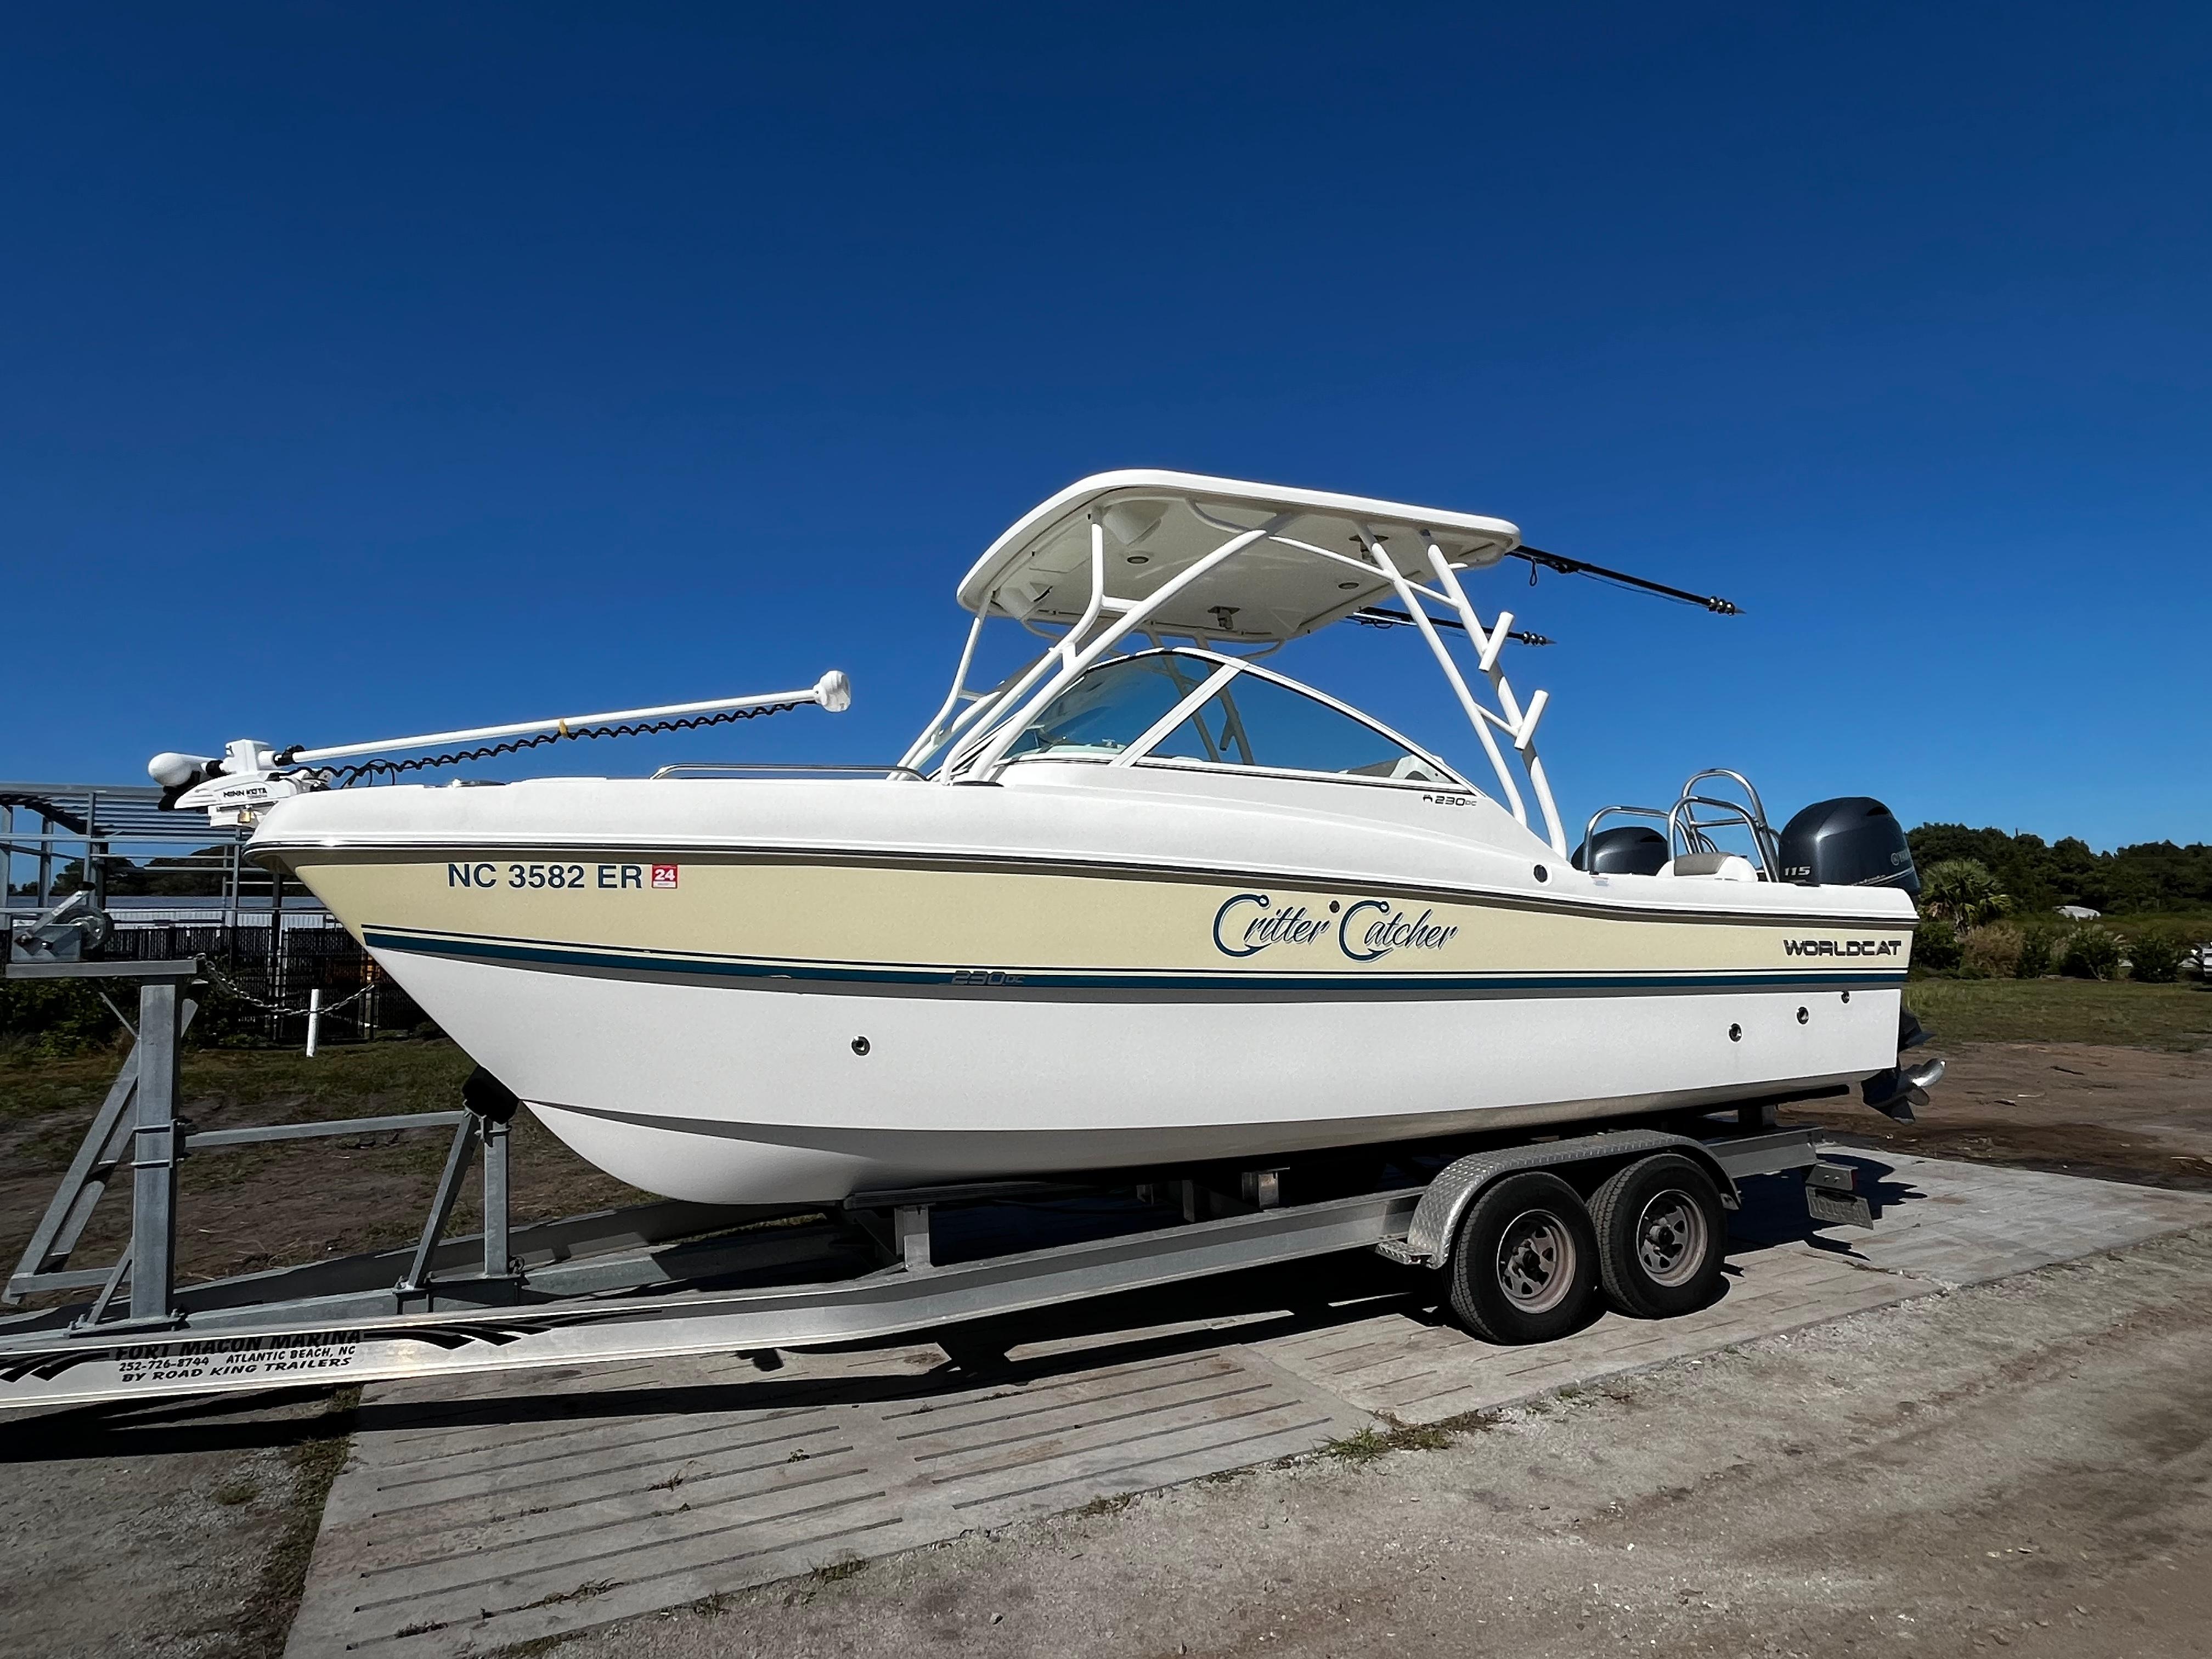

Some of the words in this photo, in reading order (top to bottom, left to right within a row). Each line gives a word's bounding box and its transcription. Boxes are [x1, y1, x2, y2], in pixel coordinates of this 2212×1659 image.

[448, 863, 496, 888] NC
[508, 864, 585, 889] 3582
[597, 865, 642, 889] ER
[654, 868, 675, 881] 24
[1784, 866, 1811, 876] 115
[1212, 893, 1331, 957] Critter
[1339, 900, 1458, 962] Catcher
[1783, 939, 1901, 956] WORLDCAT
[116, 1344, 170, 1361] FORT
[179, 1337, 262, 1356] MACON
[269, 1329, 360, 1350] MARINA
[119, 1356, 210, 1372] 252-726-8744
[226, 1351, 285, 1364] ATLANTIC
[290, 1347, 334, 1359] BEACH,
[338, 1345, 356, 1356] NC
[122, 1372, 147, 1383] BY
[151, 1368, 204, 1380] ROAD
[210, 1364, 257, 1376] KING
[265, 1357, 352, 1372] TRAILERS
